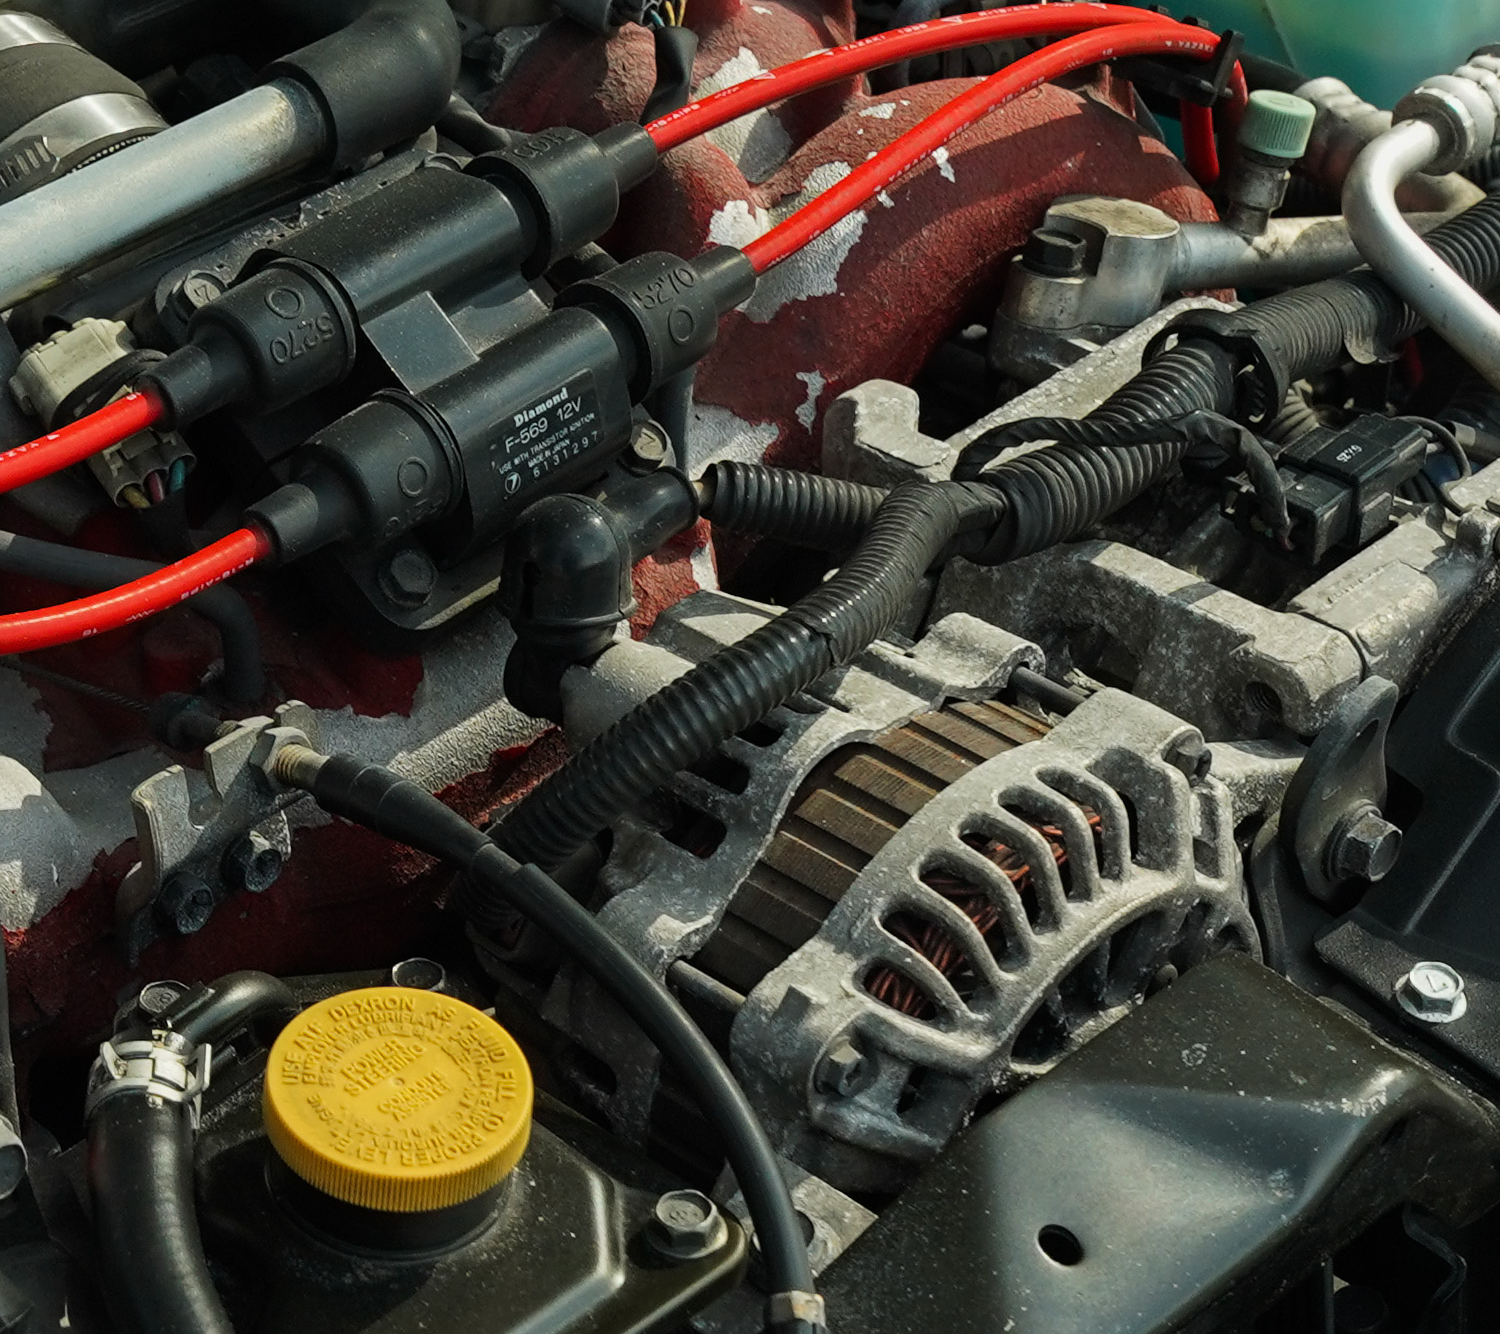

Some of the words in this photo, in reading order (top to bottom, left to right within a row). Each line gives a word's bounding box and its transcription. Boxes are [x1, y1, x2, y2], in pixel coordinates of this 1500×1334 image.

[628, 259, 703, 317] 5270
[263, 309, 342, 366] 5270
[502, 414, 550, 455] F-569
[554, 395, 585, 423] 12V
[511, 385, 570, 428] Diamond
[528, 425, 570, 456] TRANSISTOR
[328, 995, 417, 1023] DEXRON
[341, 1037, 406, 1080] POWER
[467, 1019, 508, 1062] FLUID
[281, 1048, 302, 1085] USE
[343, 1044, 427, 1097] STEERING
[494, 1069, 516, 1101] FILL
[399, 1134, 484, 1167] PROPER
